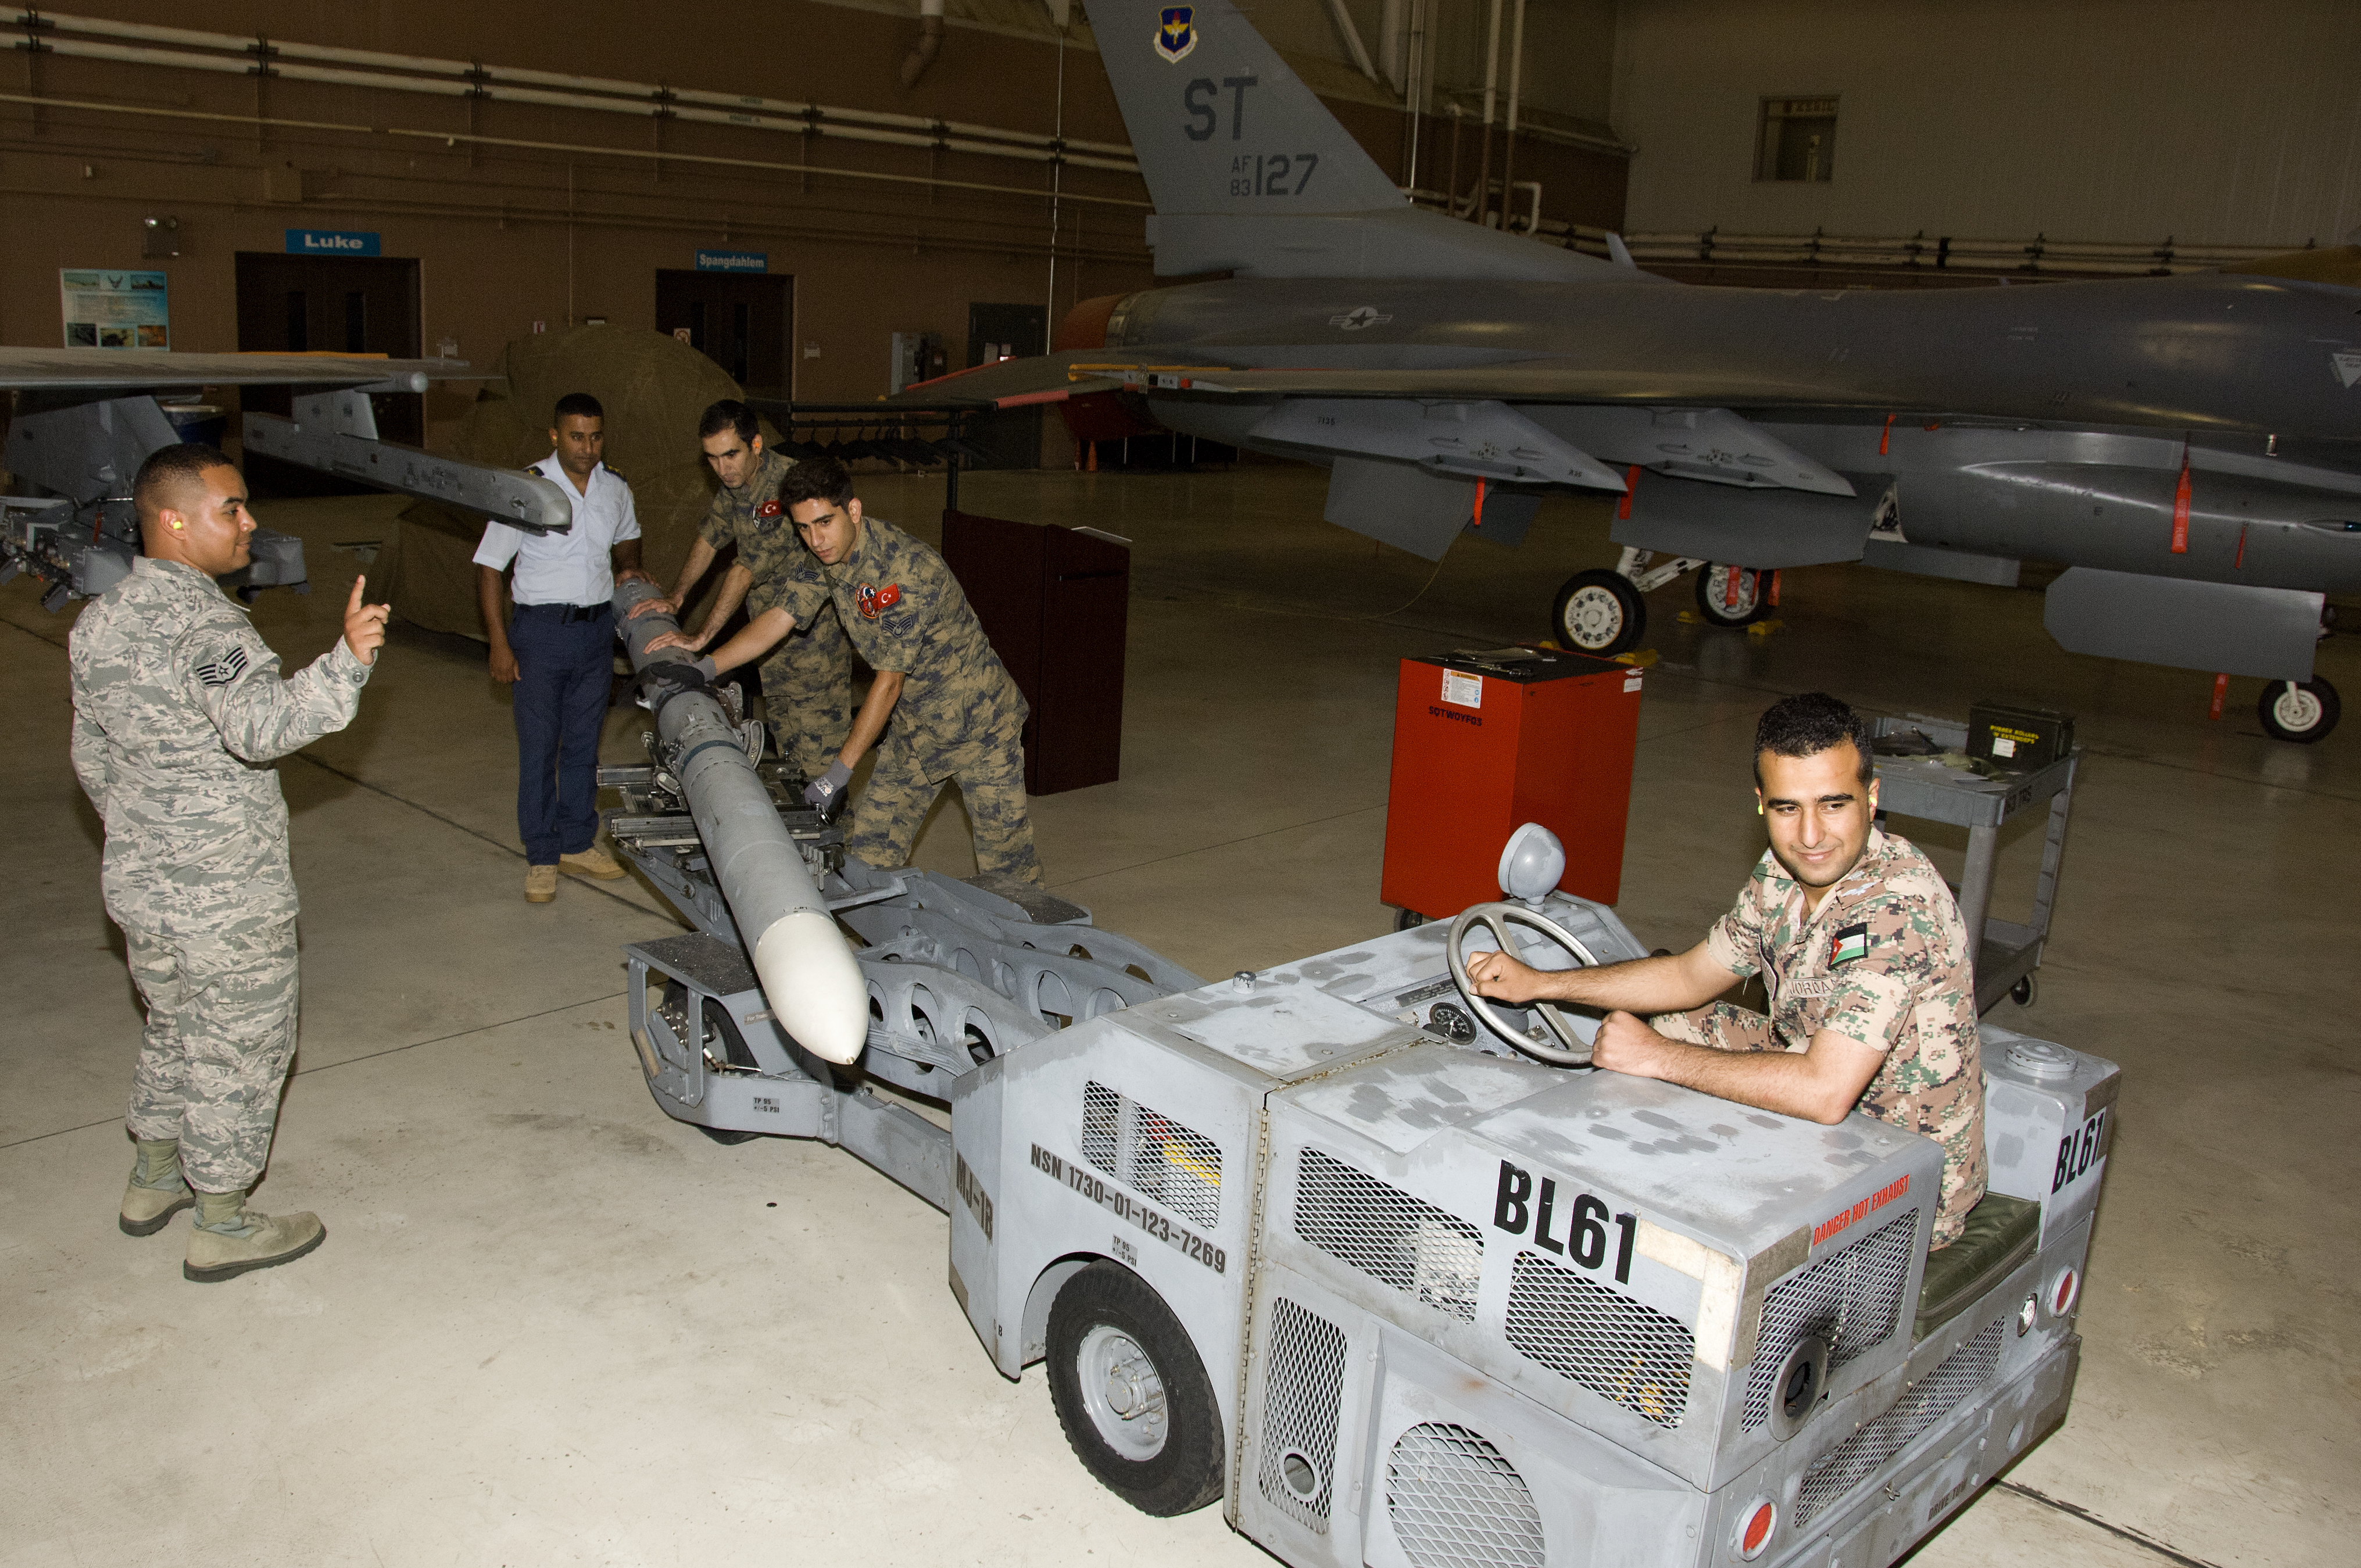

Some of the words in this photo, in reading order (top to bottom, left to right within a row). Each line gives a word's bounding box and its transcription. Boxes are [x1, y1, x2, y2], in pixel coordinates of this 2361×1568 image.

[1184, 76, 1258, 141] ST
[1232, 155, 1251, 173] AF
[1255, 153, 1319, 196] 127
[1230, 178, 1251, 196] 83
[305, 234, 364, 249] Luke
[700, 253, 764, 269] Spangdahlem
[2051, 1112, 2105, 1195] BL61
[956, 1151, 993, 1240] MJ-1B
[1031, 1143, 1062, 1181] NSN
[1069, 1165, 1226, 1274] 1730-01-123-7269
[1813, 1209, 1851, 1247] DANGER
[1852, 1197, 1870, 1223] HOT
[1871, 1174, 1910, 1212] EXHAUST
[1113, 1236, 1121, 1245] TP
[1122, 1241, 1129, 1252] 95
[1494, 1159, 1637, 1286] BL61
[1128, 1254, 1136, 1267] PSI
